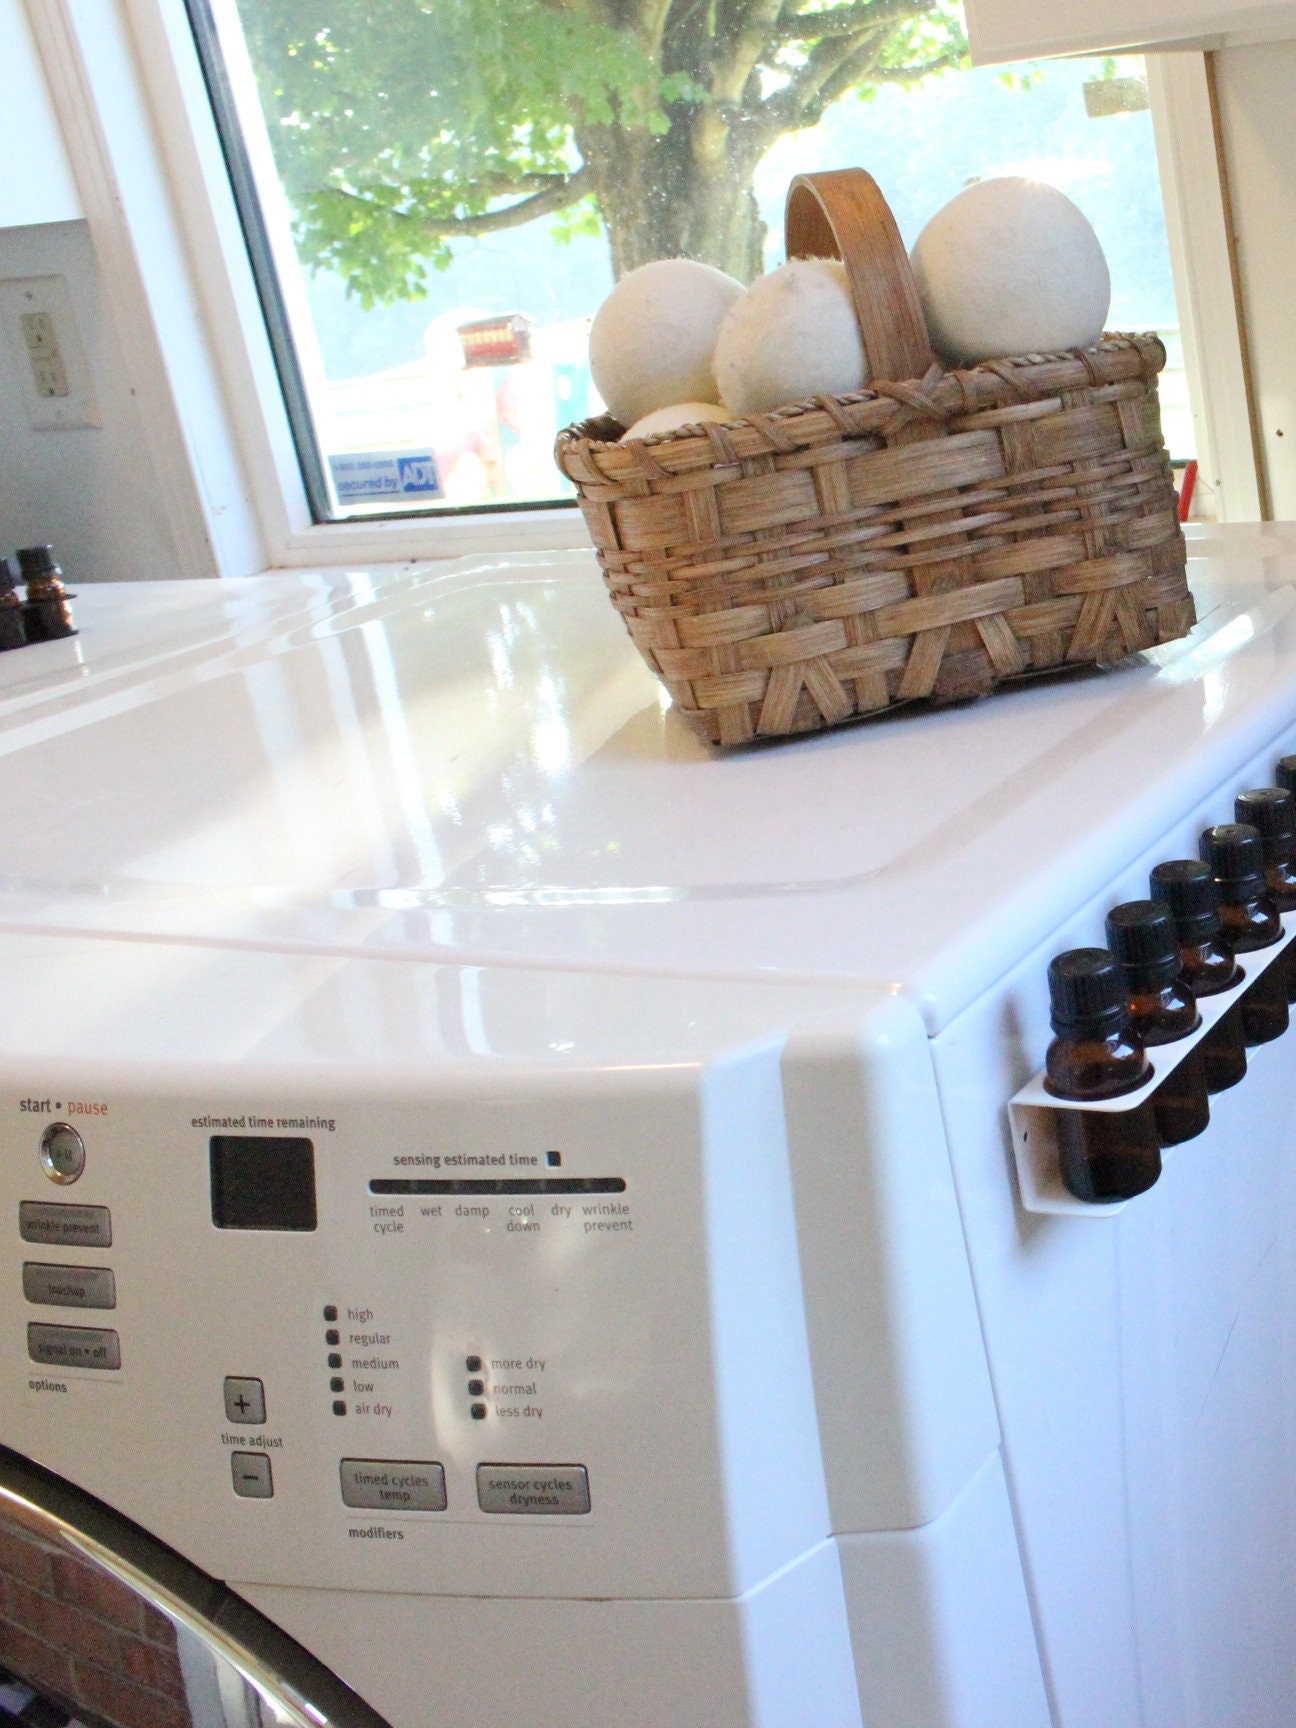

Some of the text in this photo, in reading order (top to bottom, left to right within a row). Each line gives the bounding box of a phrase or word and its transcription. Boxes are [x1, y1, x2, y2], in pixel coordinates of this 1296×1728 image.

[400, 460, 438, 488] ADT
[338, 476, 398, 492] secured by
[20, 1098, 108, 1116] start pause
[191, 1116, 336, 1132] estimated time remaining
[393, 1153, 538, 1168] sensing estimated time
[369, 1205, 404, 1218] timed
[420, 1206, 442, 1217] wet
[455, 1204, 490, 1219] damp
[508, 1204, 535, 1217] cool
[551, 1203, 572, 1218] dry
[582, 1203, 630, 1216] wrinkle
[26, 1218, 100, 1235] wrinkle prevent
[373, 1220, 404, 1235] cycle
[506, 1220, 541, 1233] down
[584, 1219, 633, 1233] prevent
[347, 1307, 374, 1322] high
[349, 1332, 391, 1346] regular
[37, 1342, 107, 1358] signal on off
[352, 1356, 400, 1370] medium
[491, 1357, 546, 1372] more dry
[28, 1379, 67, 1393] options
[353, 1379, 374, 1392] low
[493, 1382, 537, 1396] normal
[355, 1402, 392, 1418] air dry
[495, 1405, 543, 1420] less dry
[221, 1432, 283, 1449] time adjust
[354, 1472, 429, 1488] timed cycles
[489, 1477, 573, 1493] sensor cycles
[379, 1488, 411, 1503] temp
[509, 1492, 560, 1507] dryness
[348, 1526, 404, 1540] modifiers
